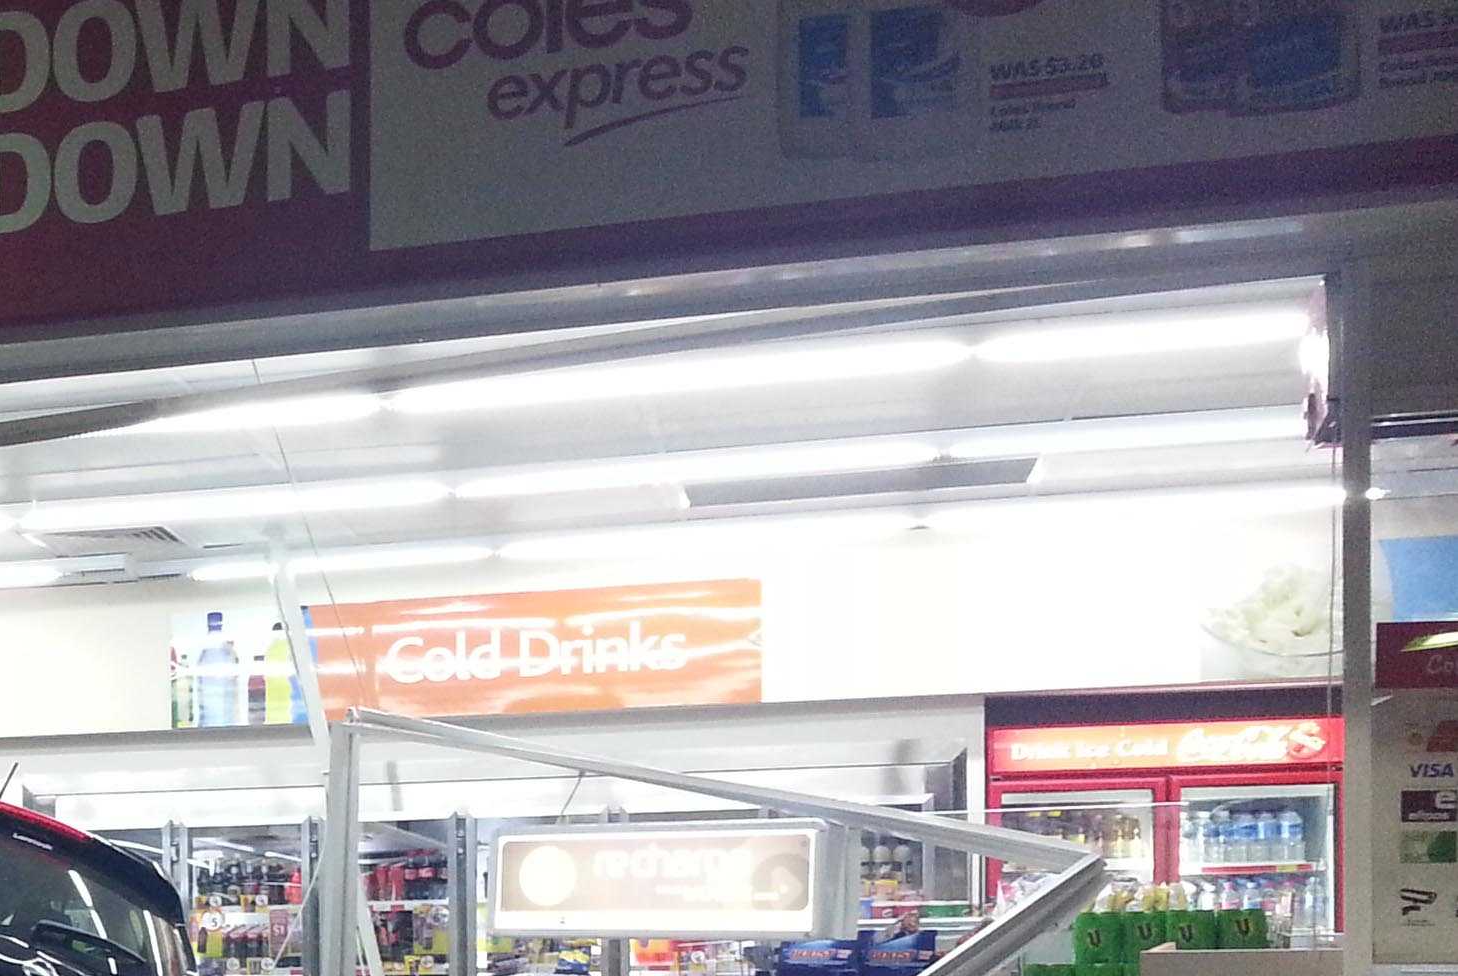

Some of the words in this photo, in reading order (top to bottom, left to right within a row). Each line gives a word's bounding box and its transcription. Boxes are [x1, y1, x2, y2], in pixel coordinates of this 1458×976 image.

[404, 0, 693, 69] coles
[487, 45, 748, 129] express
[990, 59, 1040, 80] WAS
[386, 629, 501, 684] Cold
[519, 621, 688, 678] Drinks
[1410, 763, 1454, 778] VISA
